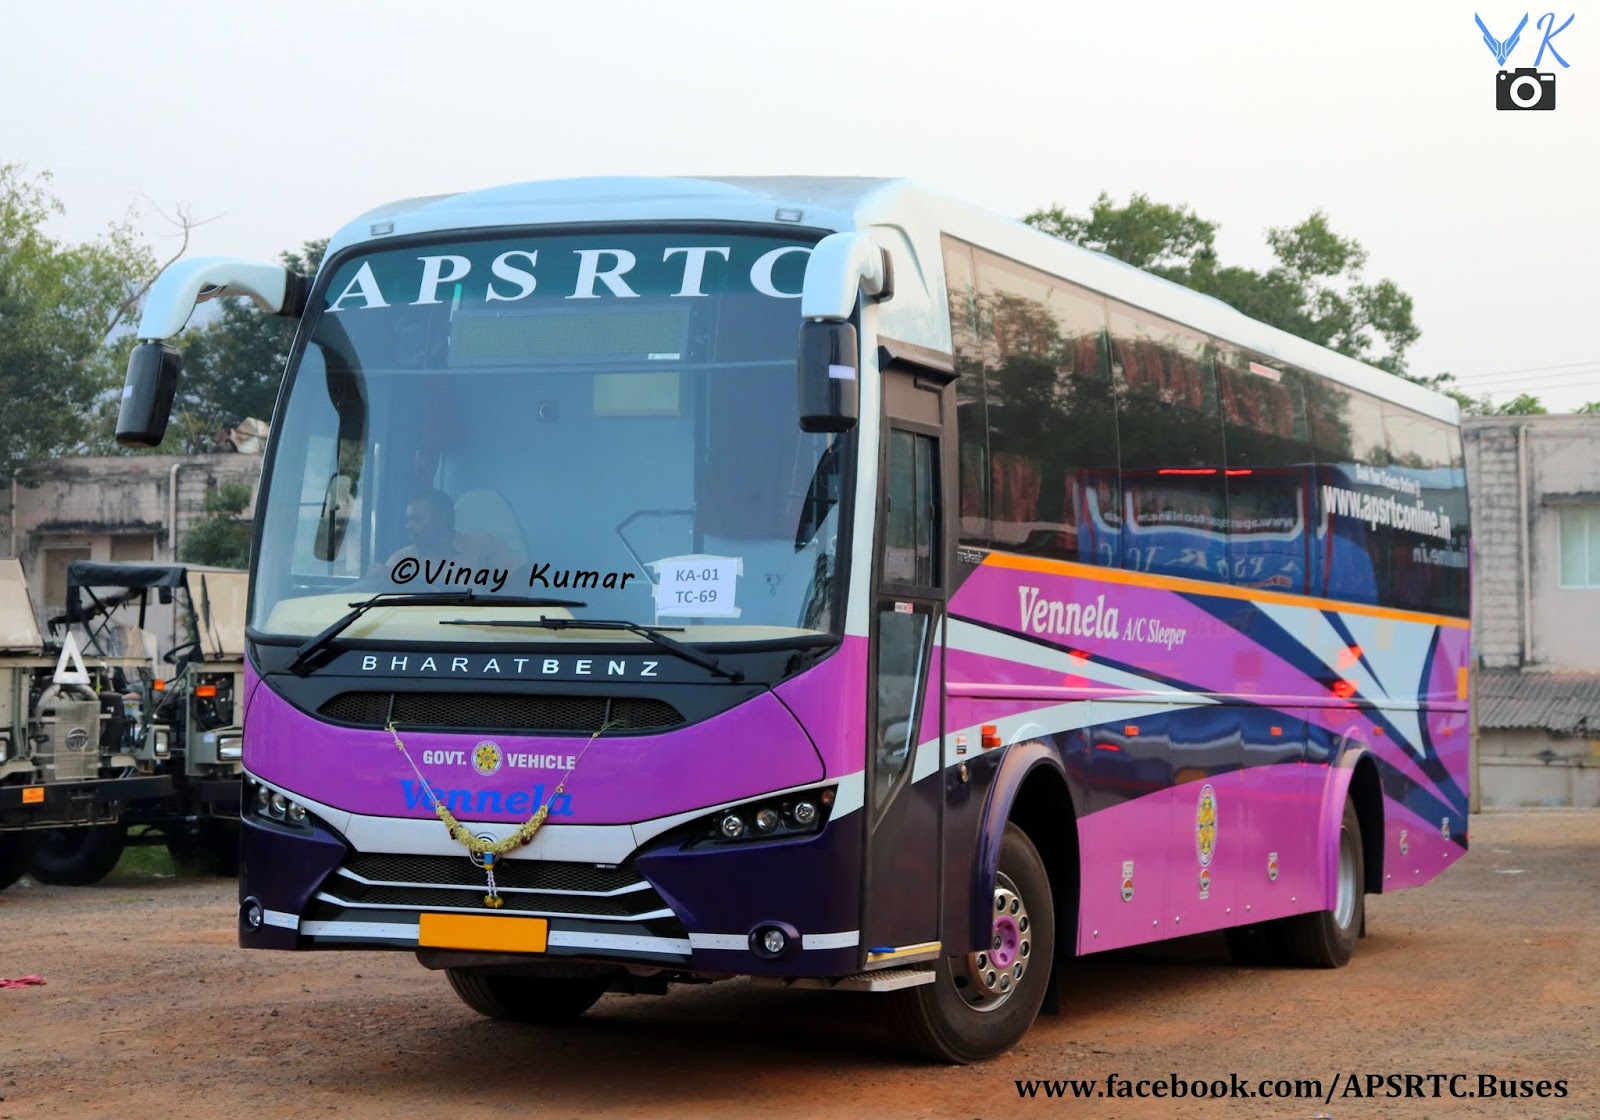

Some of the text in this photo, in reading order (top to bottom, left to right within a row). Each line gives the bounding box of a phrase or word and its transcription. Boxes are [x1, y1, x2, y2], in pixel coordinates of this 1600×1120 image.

[325, 246, 817, 313] APSRTC
[1323, 484, 1452, 541] www.apsrtconline.in
[675, 568, 720, 582] KA-01
[675, 589, 718, 604] TC-69
[1018, 585, 1187, 650] Vennela A/C Sleeper
[362, 655, 660, 677] BHARATBENZ
[422, 750, 467, 766] GOVT.
[507, 753, 576, 771] VEHICLE
[400, 780, 576, 816] Vennela
